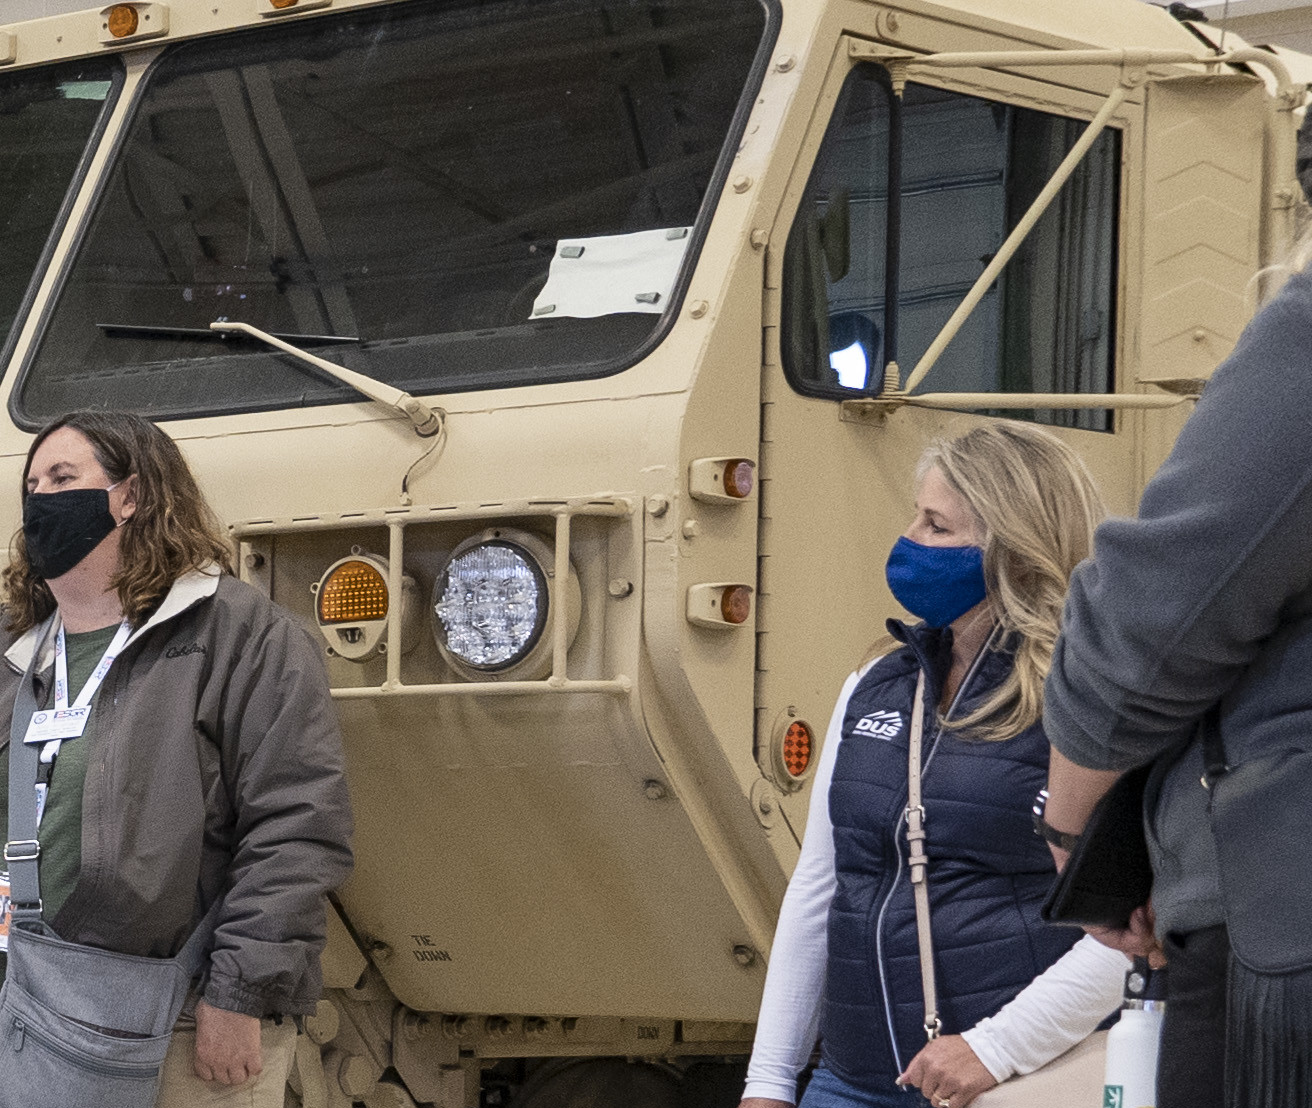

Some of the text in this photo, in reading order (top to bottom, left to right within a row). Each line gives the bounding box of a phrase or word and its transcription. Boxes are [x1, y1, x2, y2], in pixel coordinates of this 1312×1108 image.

[855, 717, 900, 737] DUS
[410, 934, 436, 947] TIE
[412, 950, 453, 962] DOWN
